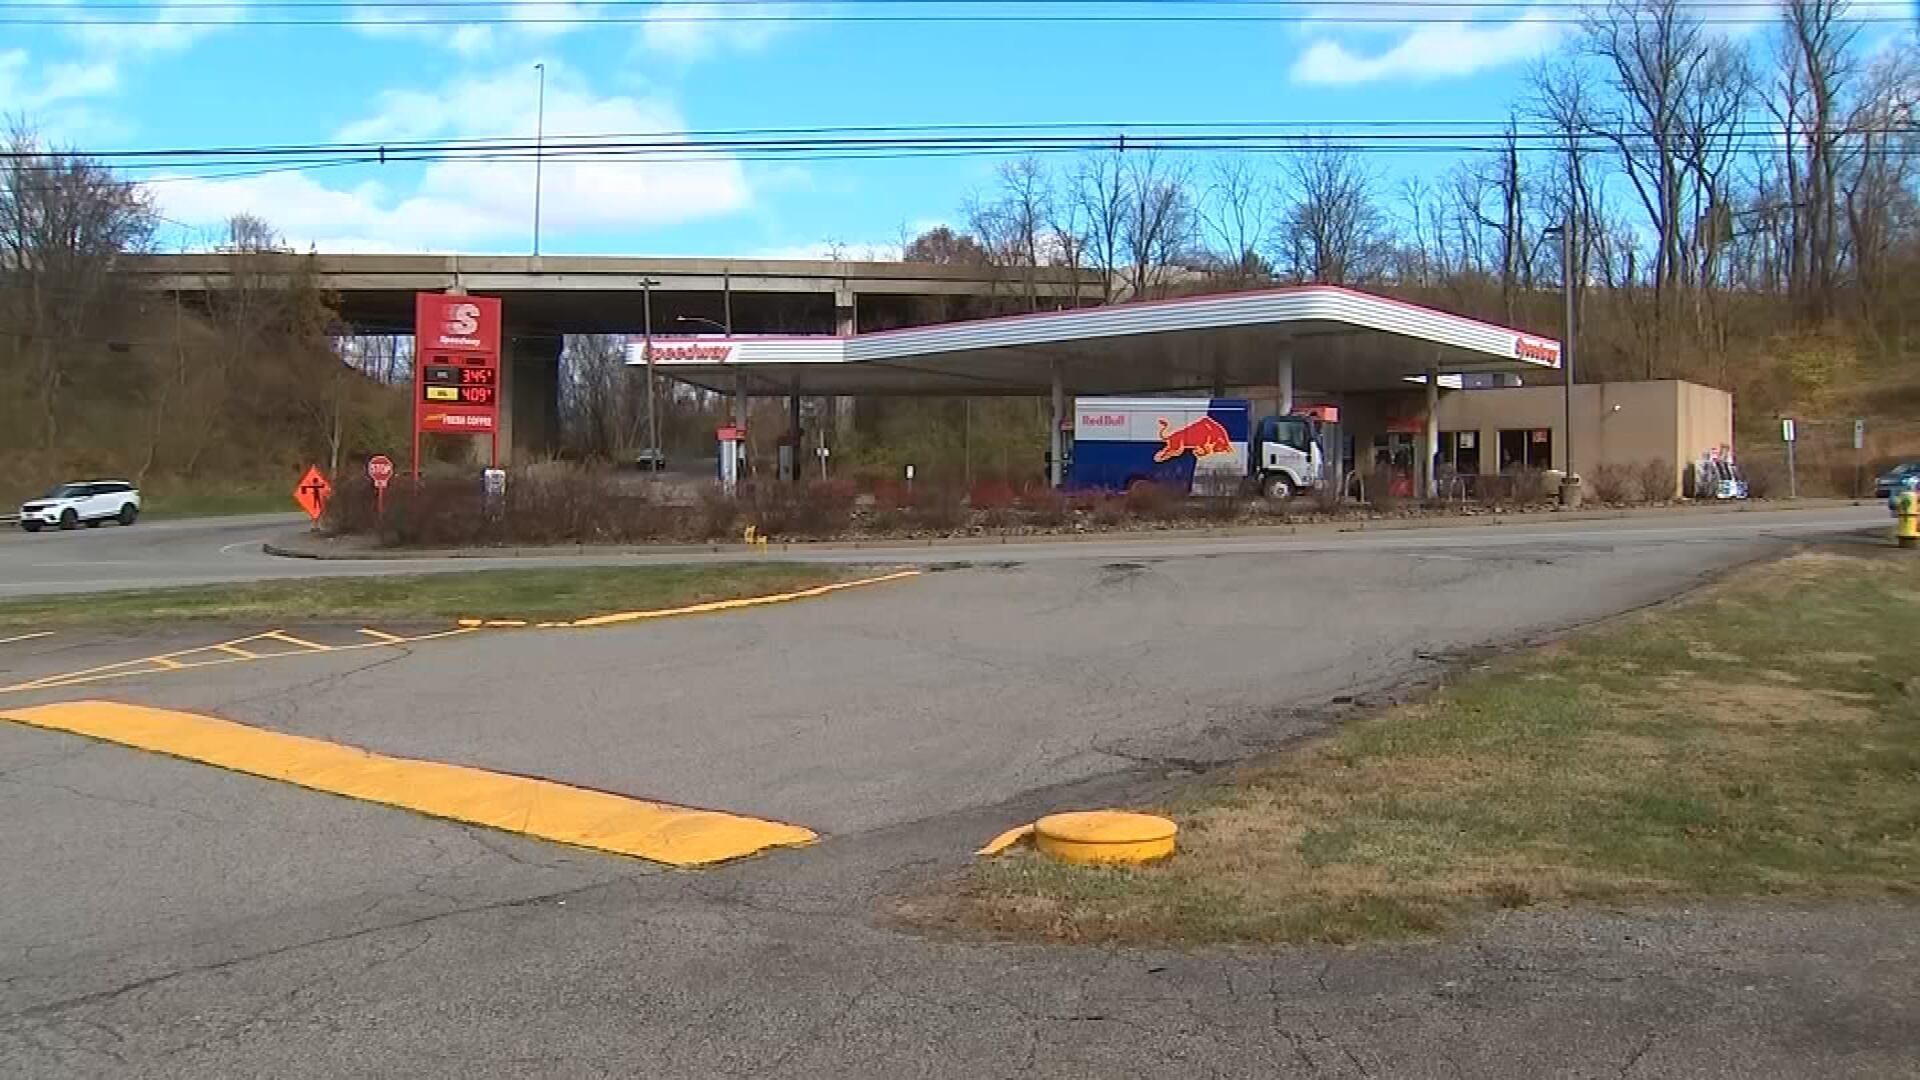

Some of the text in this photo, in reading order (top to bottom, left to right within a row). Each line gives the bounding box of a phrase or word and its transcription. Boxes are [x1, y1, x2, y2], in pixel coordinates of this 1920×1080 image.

[641, 341, 732, 363] Speedway
[1082, 415, 1125, 426] Red Bull
[370, 462, 391, 473] STOP
